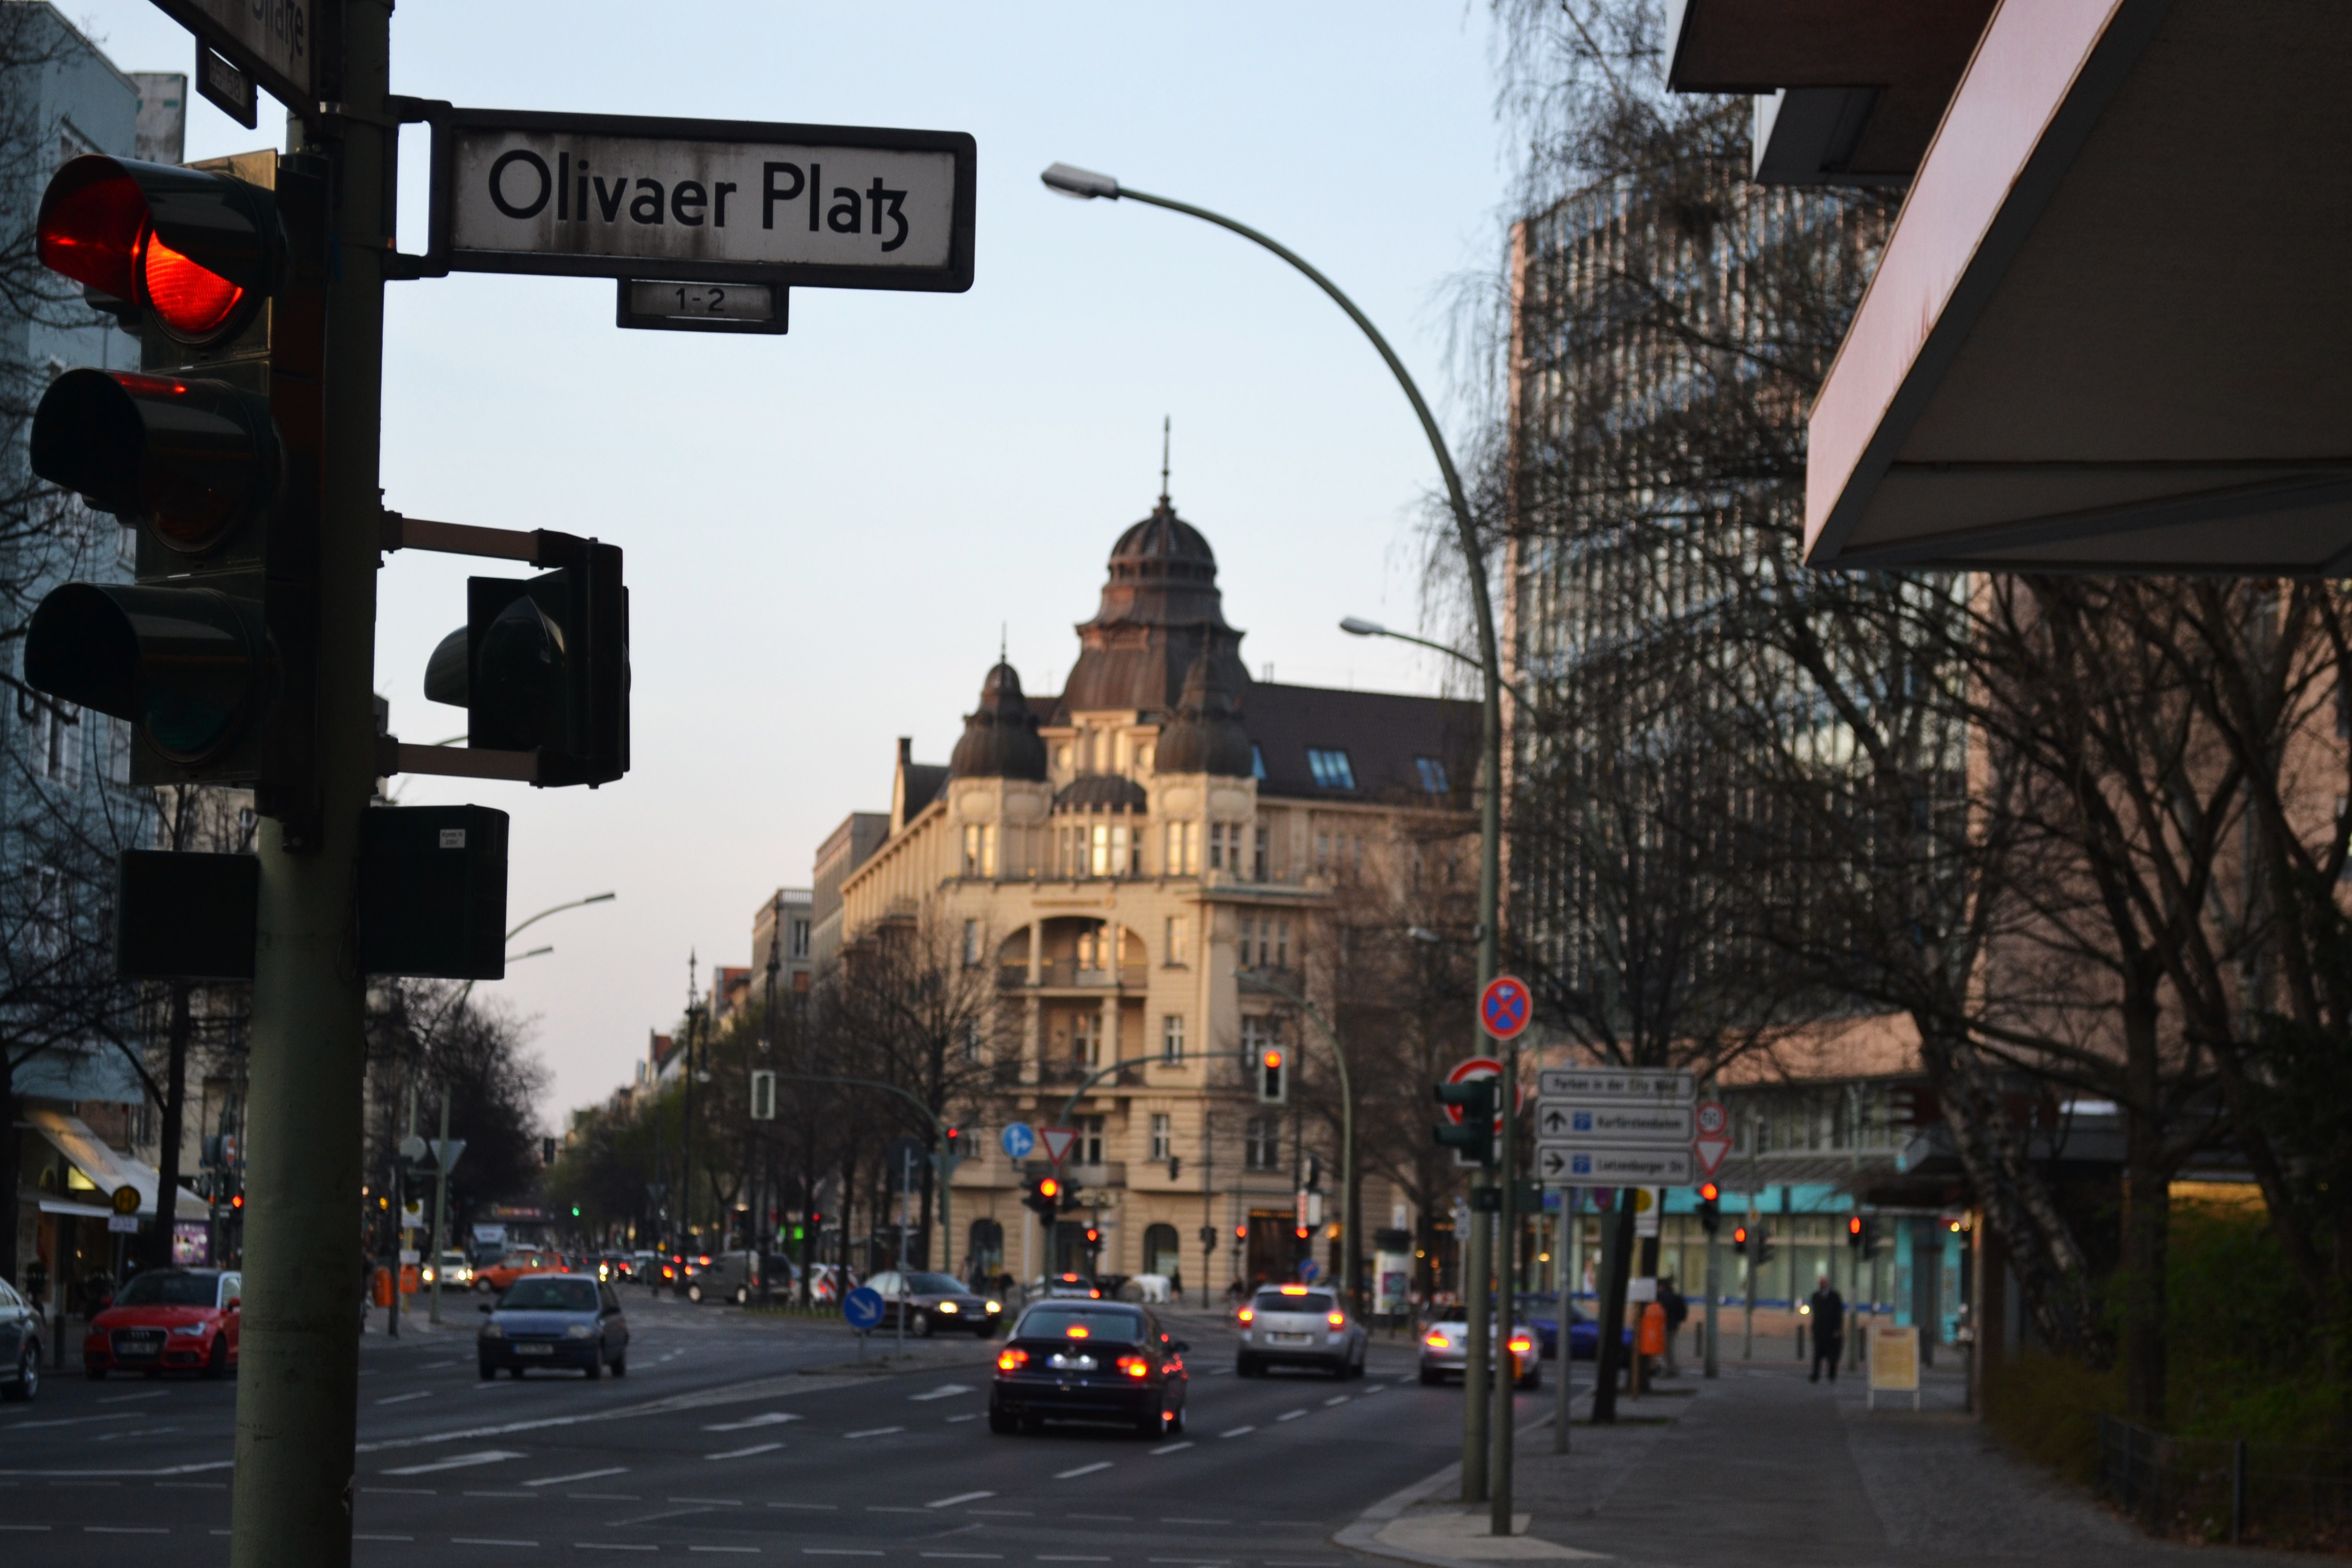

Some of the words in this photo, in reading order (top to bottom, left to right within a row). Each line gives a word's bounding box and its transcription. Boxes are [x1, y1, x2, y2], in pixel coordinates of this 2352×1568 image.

[488, 149, 737, 228] Olivaer
[763, 161, 909, 252] Platz
[675, 287, 725, 312] 1-2
